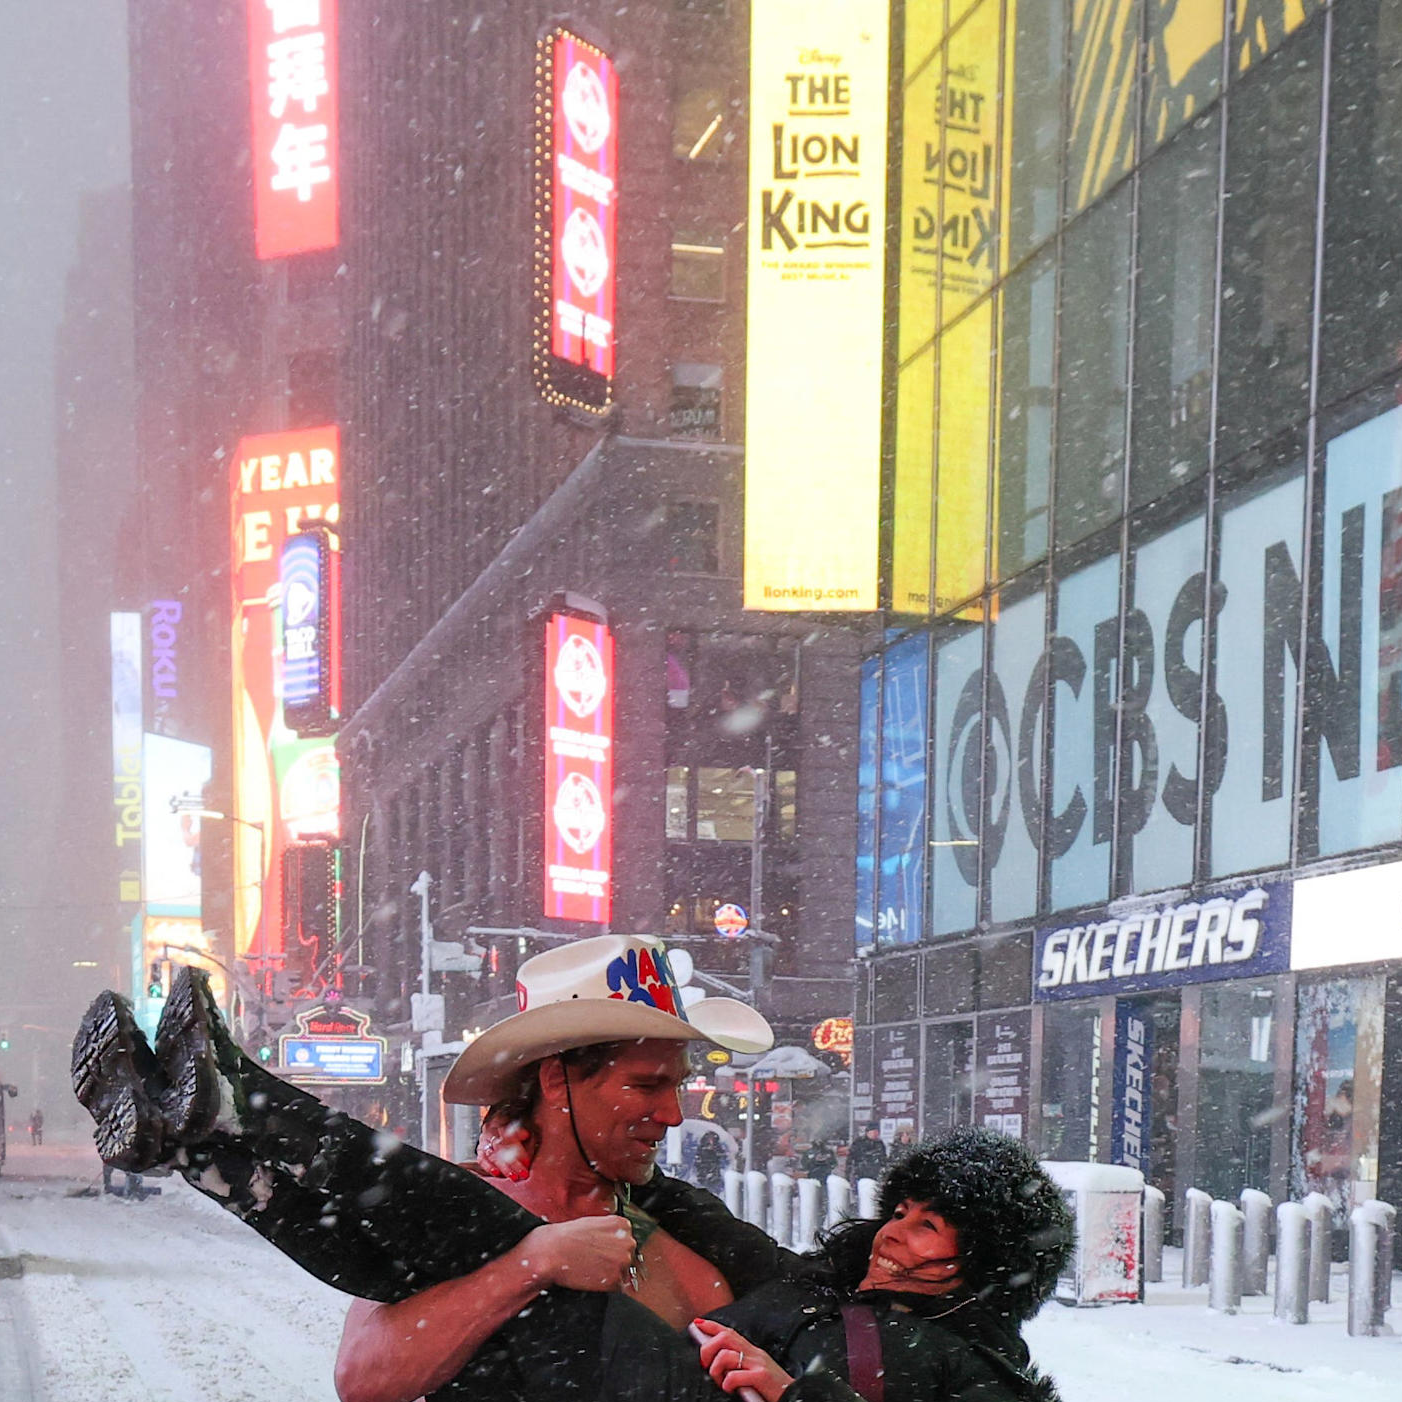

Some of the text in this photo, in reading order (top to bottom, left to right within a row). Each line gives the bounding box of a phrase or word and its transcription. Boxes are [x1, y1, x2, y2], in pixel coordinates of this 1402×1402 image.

[785, 74, 850, 105] THE
[772, 123, 859, 180] LION
[761, 190, 870, 252] KING
[240, 448, 336, 494] YEAR
[763, 585, 859, 601] lionking.com
[285, 625, 317, 649] TACO
[1018, 572, 1229, 860] CBS
[1038, 890, 1269, 989] SKECHERS
